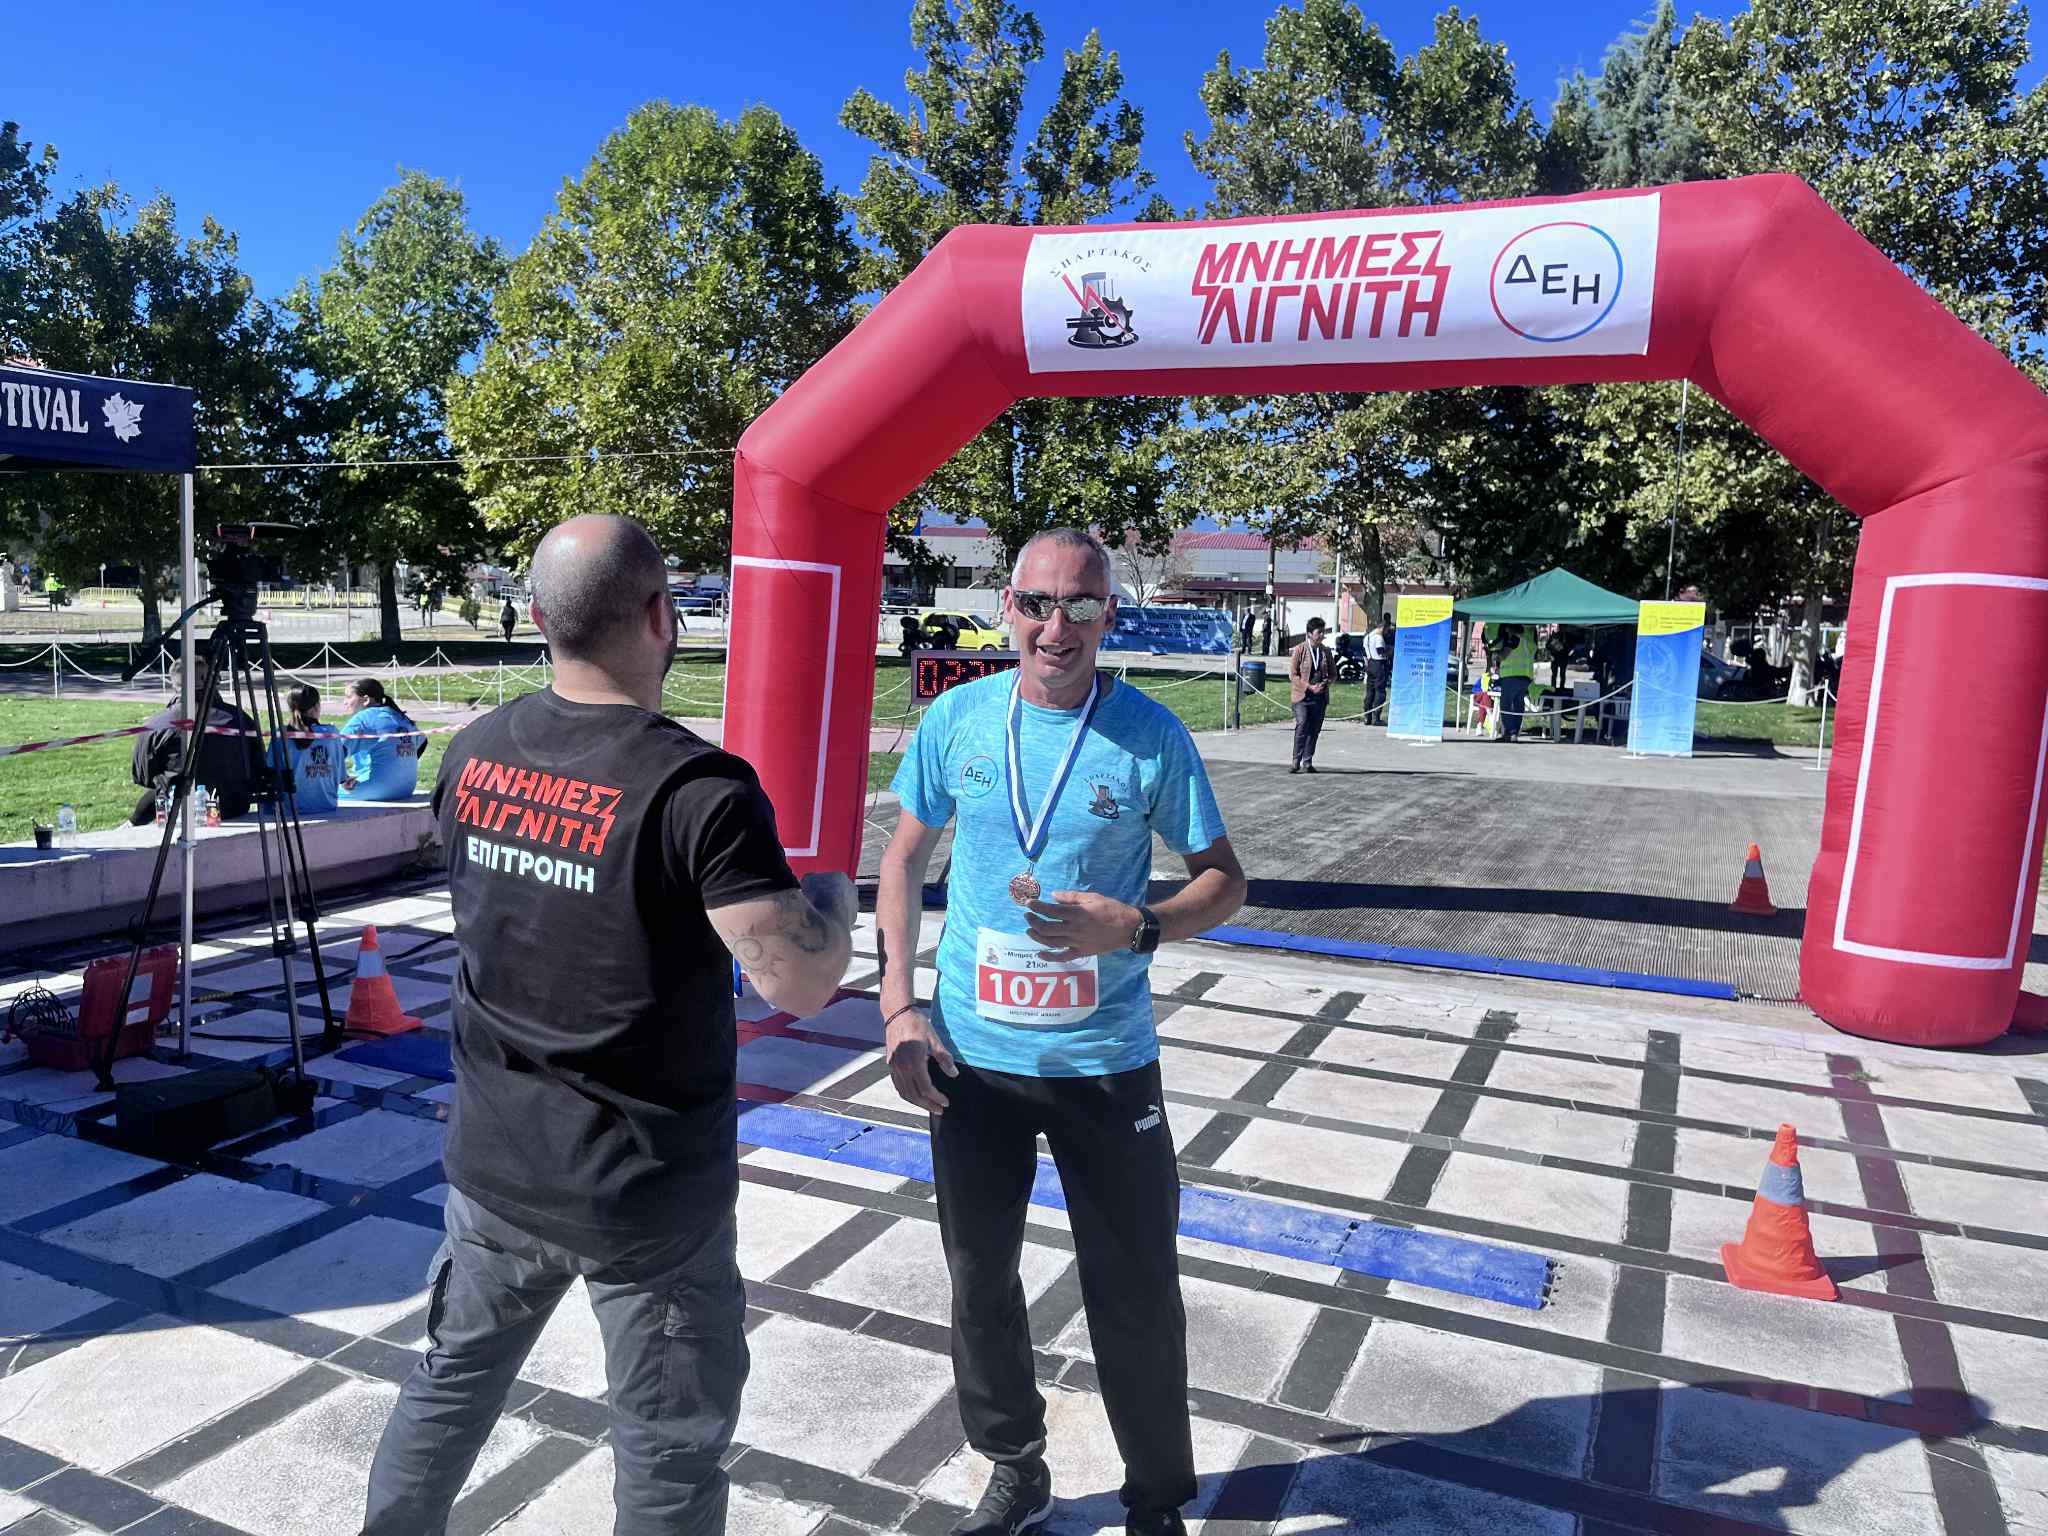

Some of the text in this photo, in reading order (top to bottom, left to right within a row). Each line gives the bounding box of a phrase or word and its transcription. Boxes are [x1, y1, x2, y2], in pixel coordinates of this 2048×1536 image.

[1049, 247, 1152, 278] ΣΠΑΡΤΑΚΟΣ
[1194, 229, 1446, 285] ΜΝΗΜΕΣ
[1503, 254, 1601, 306] ΔΕΗ
[1196, 268, 1449, 345] ΛΙΓΝΙΤΗ
[0, 381, 89, 434] TIVAL
[456, 757, 624, 818] ΜΝΗΜΕΣ
[965, 766, 992, 788] ΔΕΗ
[455, 795, 616, 856] ΛΙΓΝΙΤΗ
[467, 835, 595, 894] ΕΠΙΤΡΟΠΗ
[988, 972, 1080, 1007] 1071
[1134, 1112, 1161, 1134] PUMA
